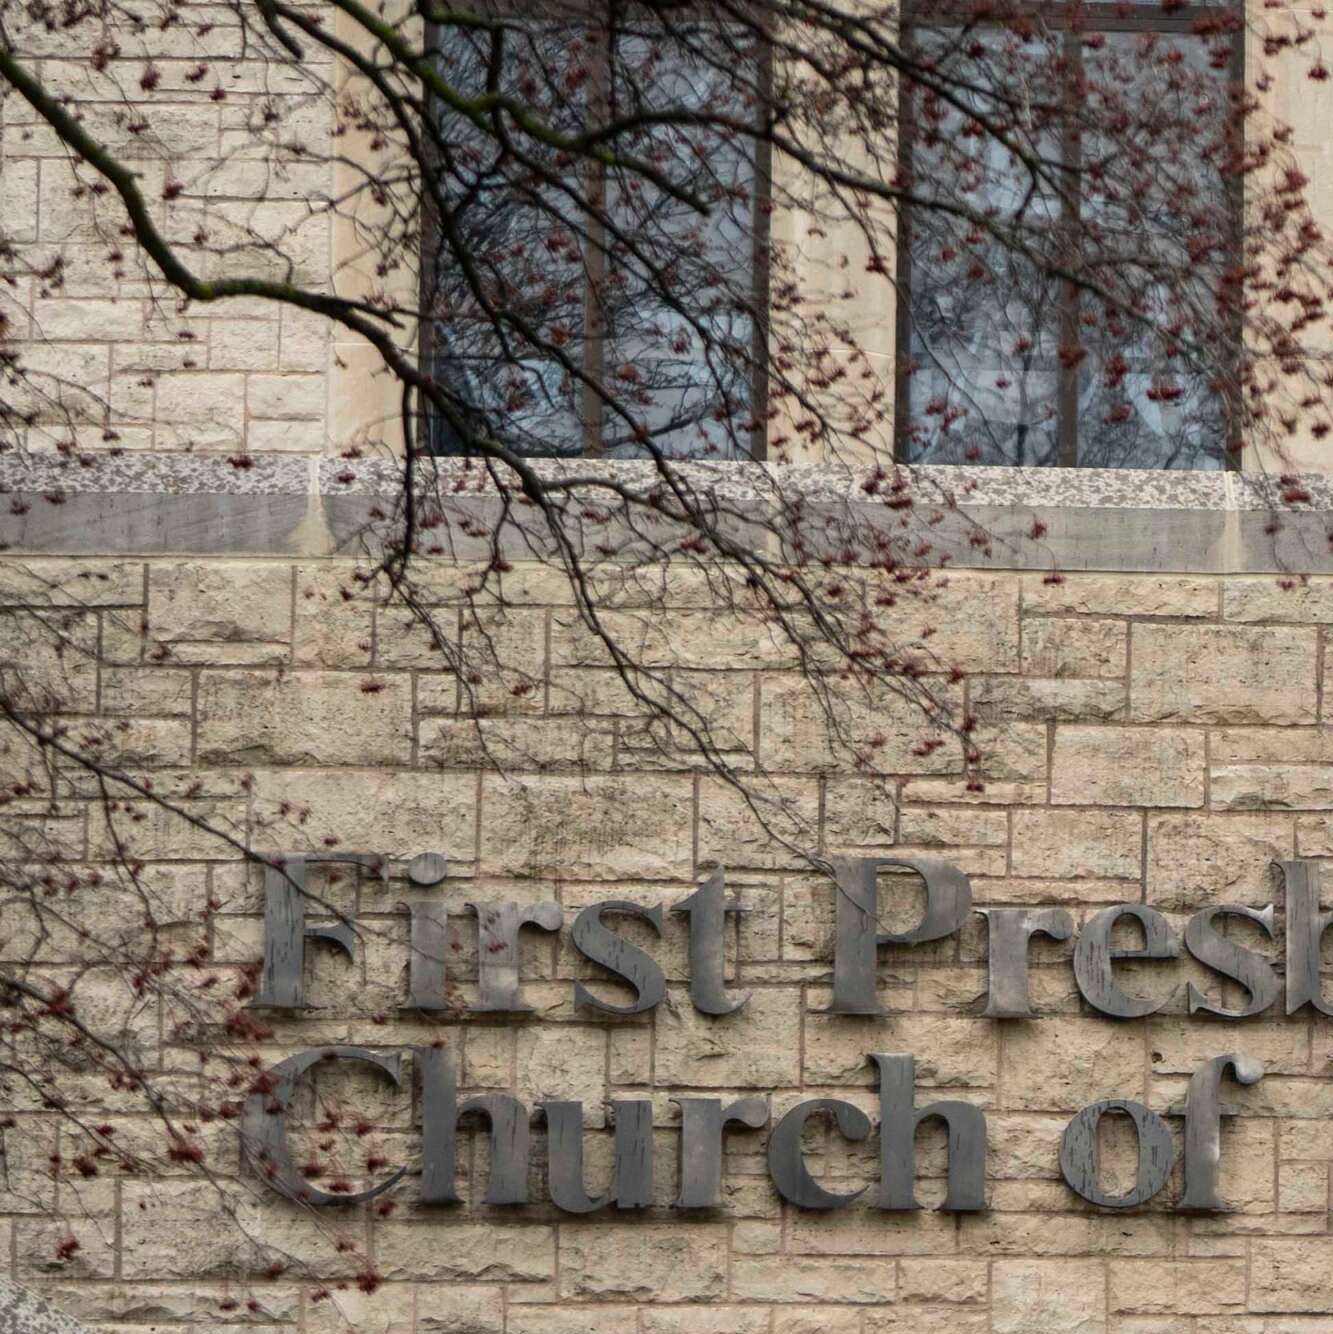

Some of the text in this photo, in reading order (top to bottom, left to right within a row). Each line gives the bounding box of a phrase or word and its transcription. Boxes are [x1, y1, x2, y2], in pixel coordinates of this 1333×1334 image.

[246, 851, 757, 1015] First
[238, 1042, 991, 1215] Church
[1058, 1054, 1265, 1217] of
